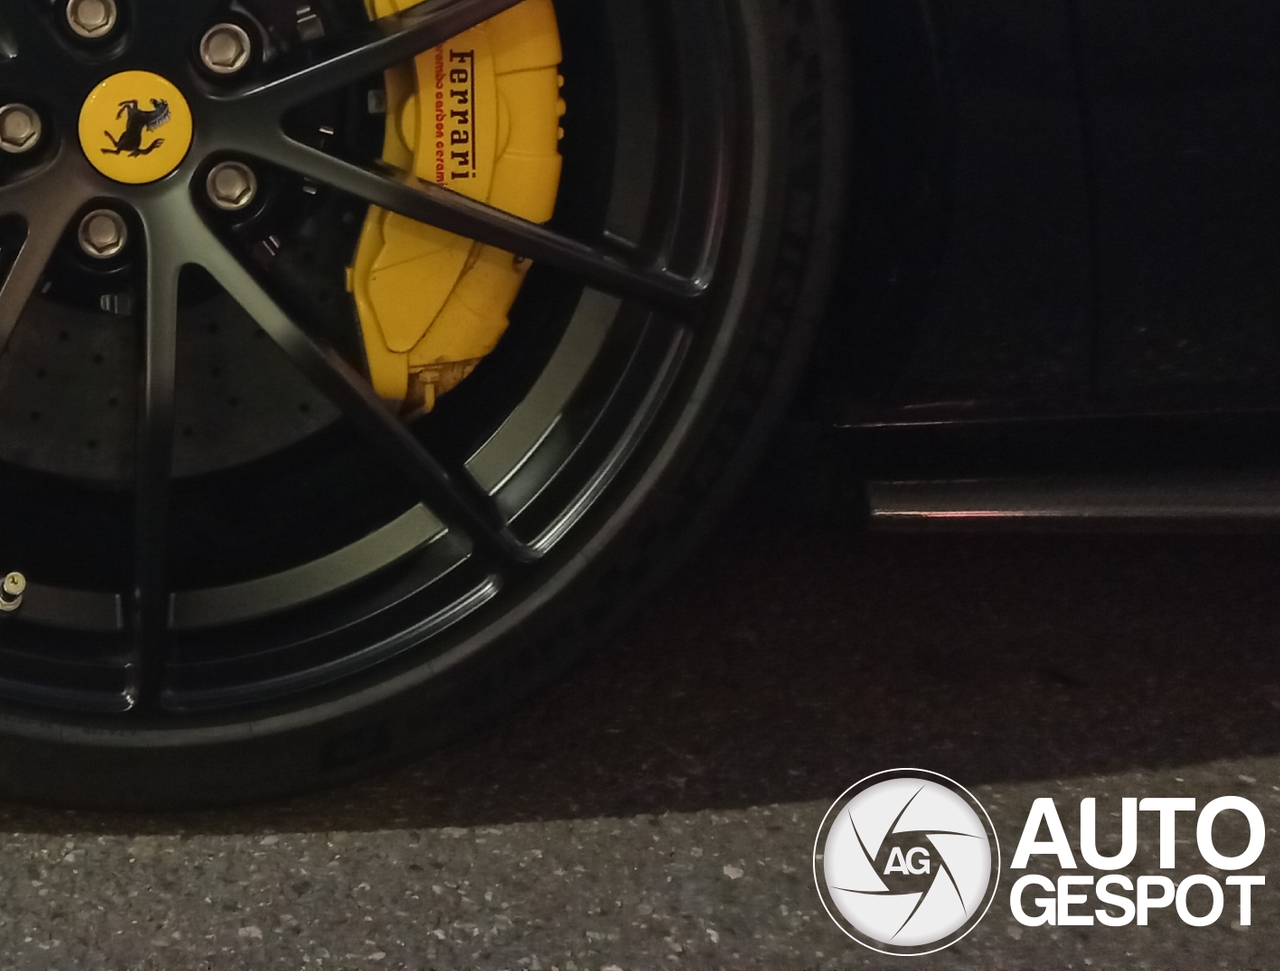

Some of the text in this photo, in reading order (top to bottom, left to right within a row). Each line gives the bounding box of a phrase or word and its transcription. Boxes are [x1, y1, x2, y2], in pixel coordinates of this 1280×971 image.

[435, 44, 446, 89] rembo
[435, 91, 446, 139] carbon
[449, 48, 476, 180] Ferrari
